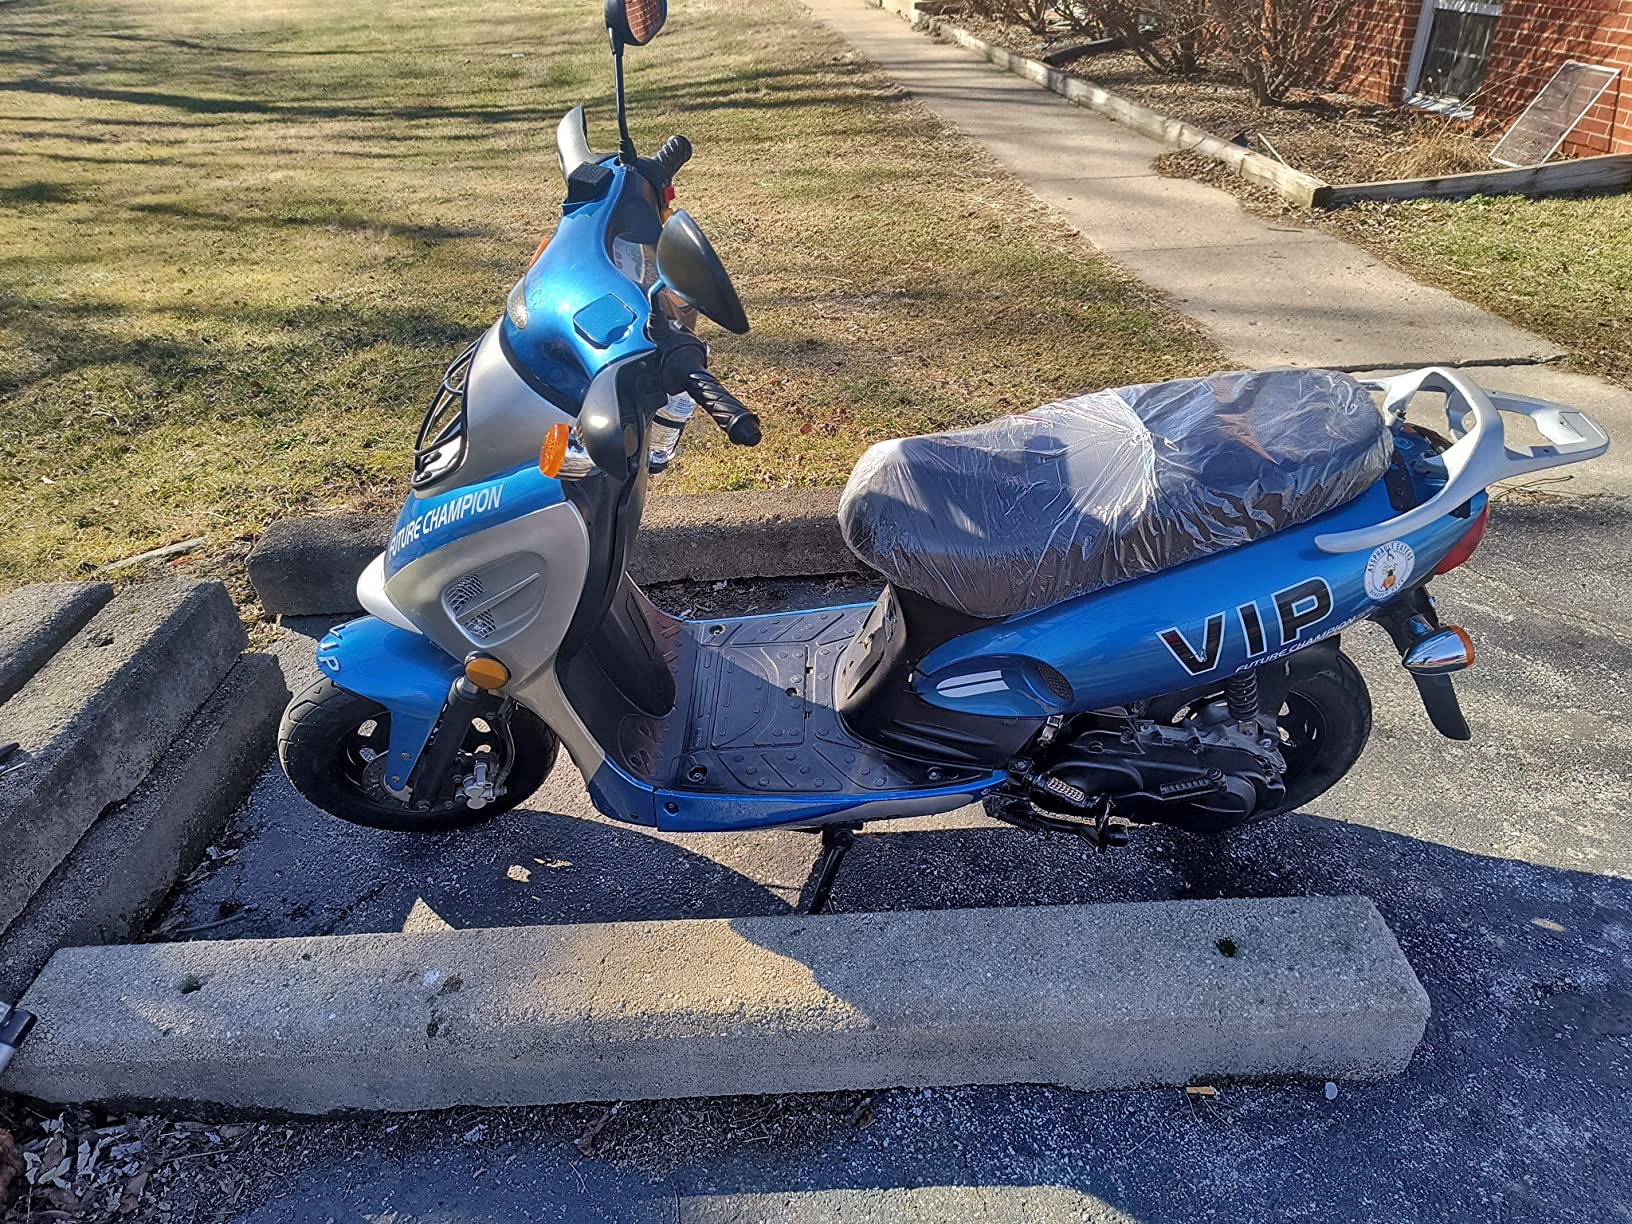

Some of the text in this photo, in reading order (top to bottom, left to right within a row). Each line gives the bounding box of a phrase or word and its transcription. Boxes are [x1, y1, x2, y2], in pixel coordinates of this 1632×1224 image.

[388, 483, 505, 561] FUTURE CHAMPION
[1156, 576, 1334, 676] VIP
[1235, 615, 1356, 673] FUTURE CHAMPION
